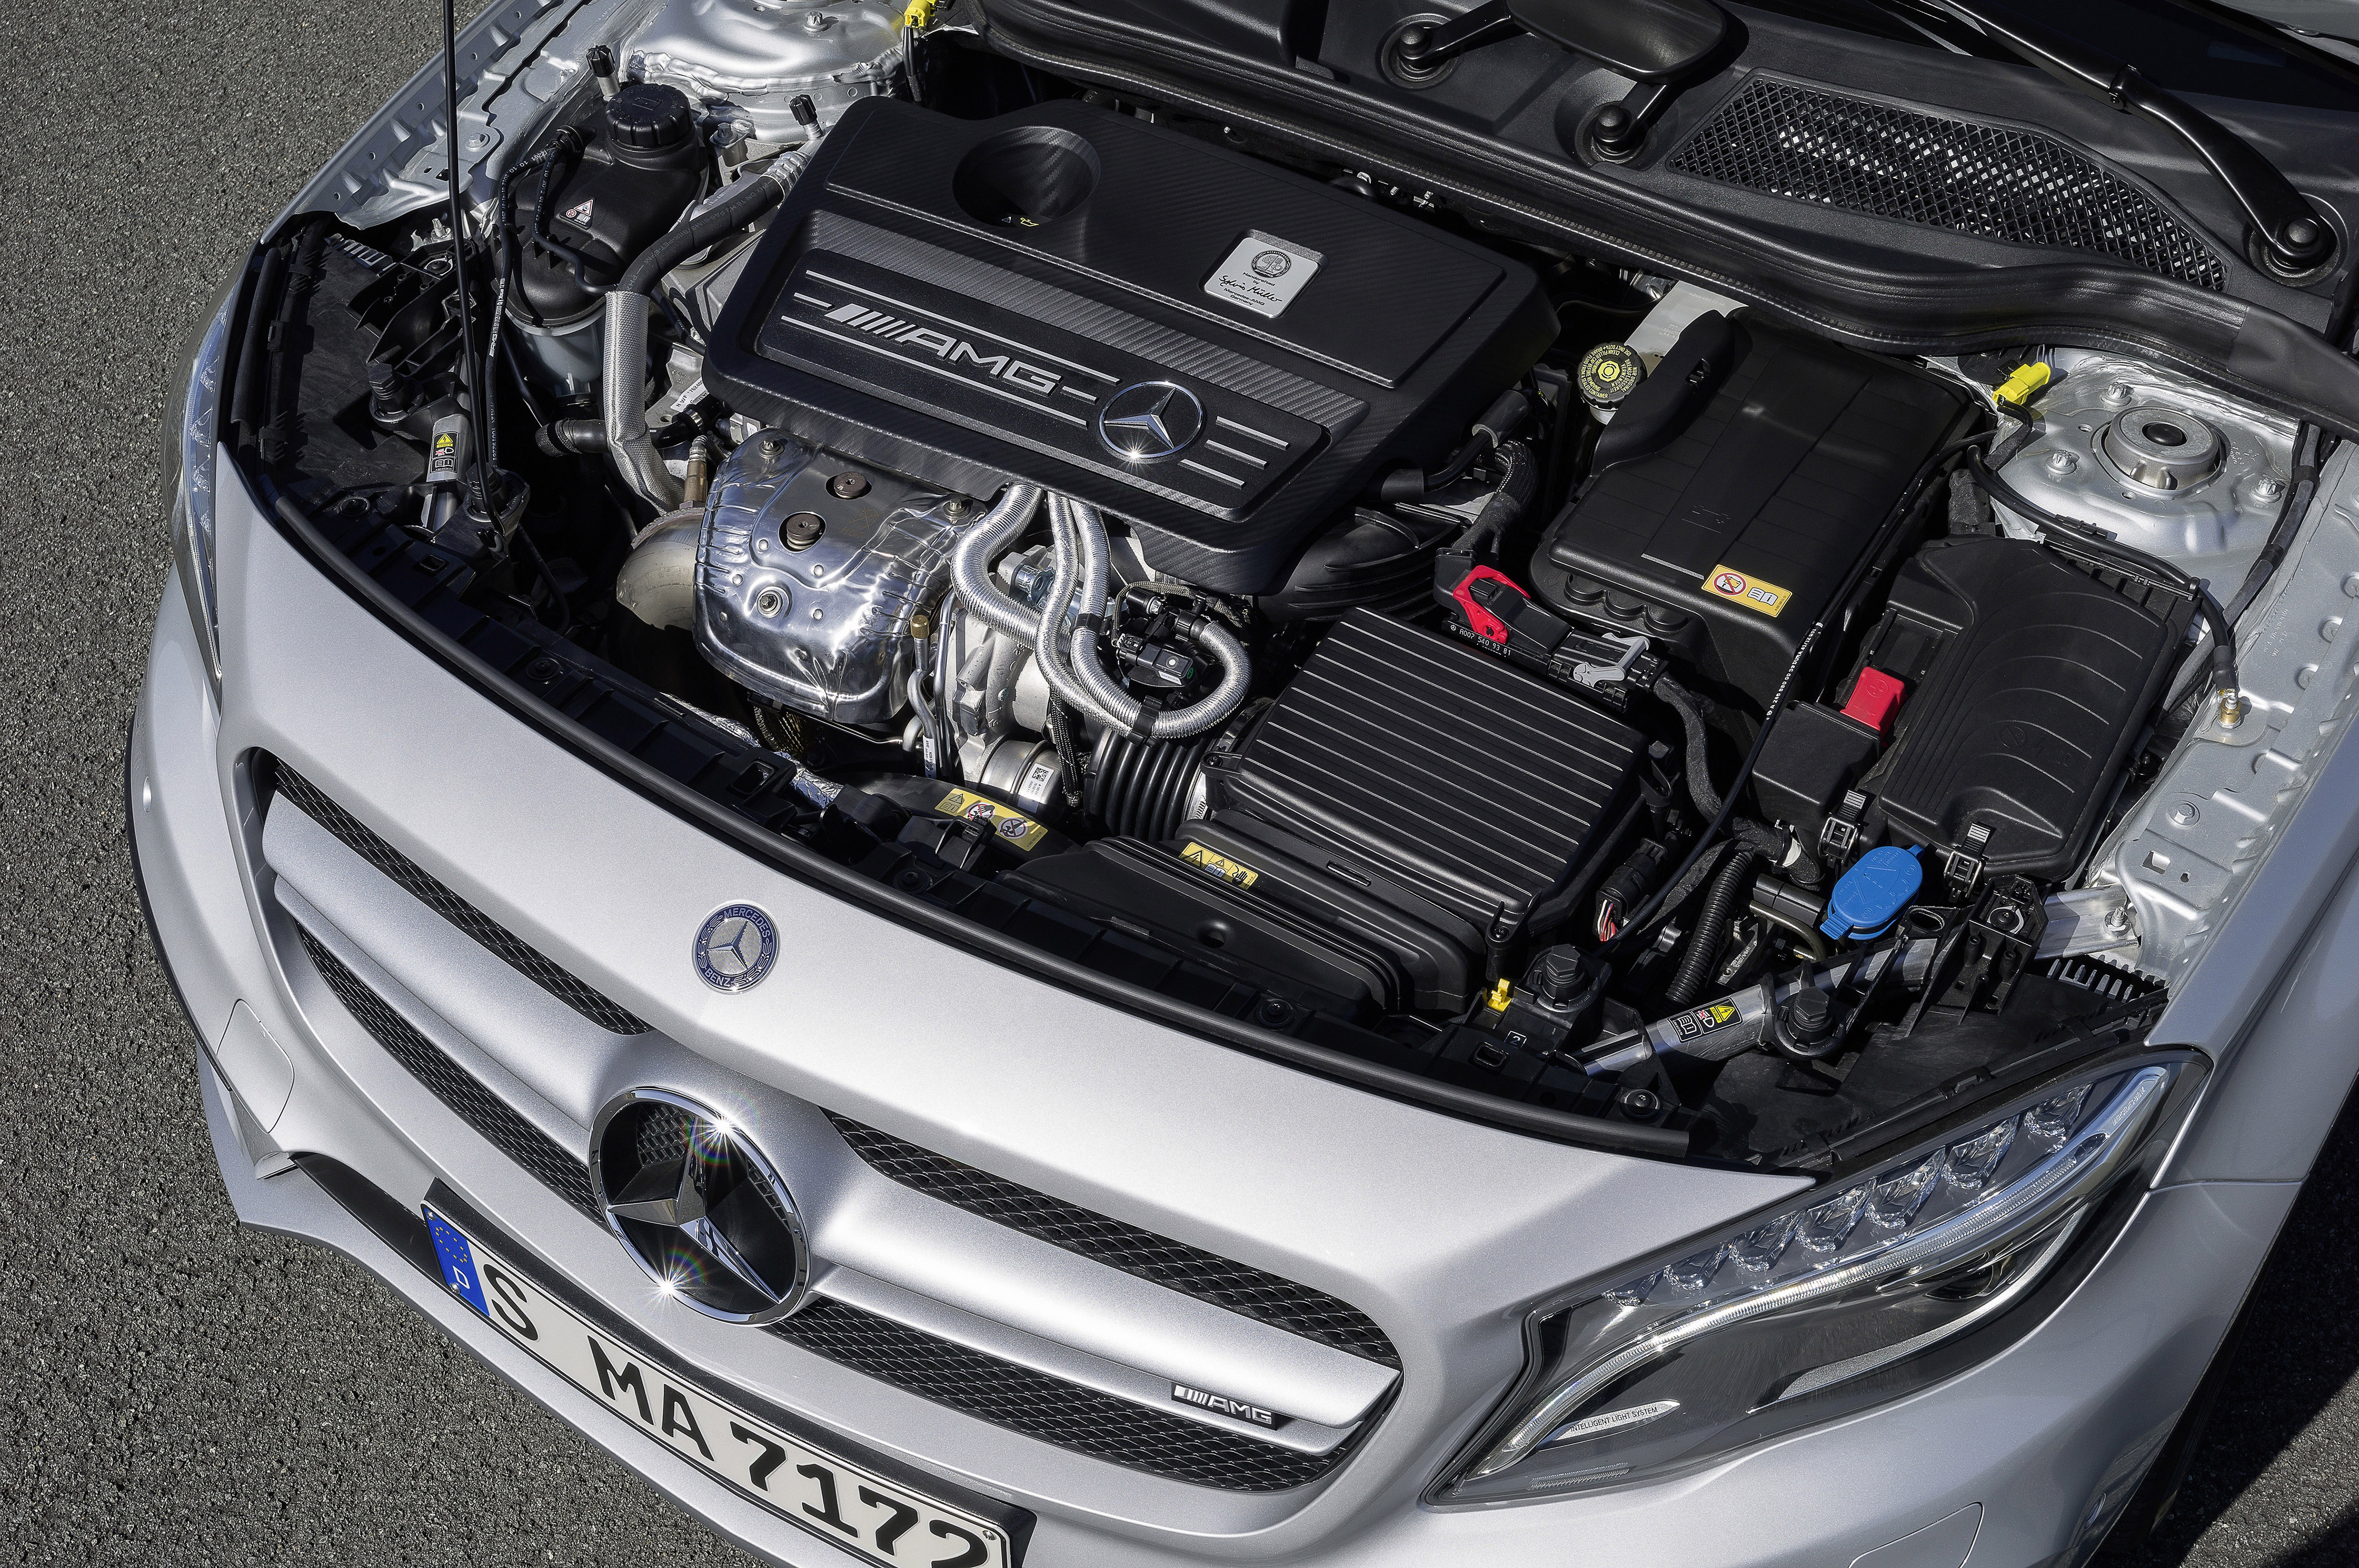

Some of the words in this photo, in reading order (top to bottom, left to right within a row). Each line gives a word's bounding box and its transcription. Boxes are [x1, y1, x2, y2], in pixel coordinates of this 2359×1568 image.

[1242, 272, 1275, 287] Handcrafted
[1223, 288, 1265, 306] Mercedes-AMG
[1230, 294, 1253, 306] Germany
[895, 328, 1062, 395] AMG
[1583, 354, 1592, 365] FLUID
[1595, 350, 1608, 359] FILLER
[1591, 358, 1603, 374] WARNING
[1586, 376, 1601, 392] REMOVING
[1611, 364, 1626, 387] VERWENDEN
[1581, 378, 1590, 391] SEALED
[1588, 388, 1608, 398] CONTAINER
[1620, 376, 1635, 393] ORIGINAL
[1459, 628, 1475, 639] A007
[1477, 637, 1490, 646] 540
[1503, 648, 1511, 656] 81
[724, 908, 771, 938] MERCEDES
[705, 968, 731, 987] BENZ
[1510, 1036, 1521, 1045] 2
[452, 1265, 470, 1289] D
[483, 1264, 538, 1341] S
[587, 1335, 715, 1462] MA
[730, 1421, 988, 1568] 7172
[1207, 1395, 1272, 1424] AMG
[1571, 1418, 1610, 1432] INTELLIGENT
[1611, 1413, 1631, 1422] LIGHT
[1633, 1407, 1658, 1417] SYSTEM
